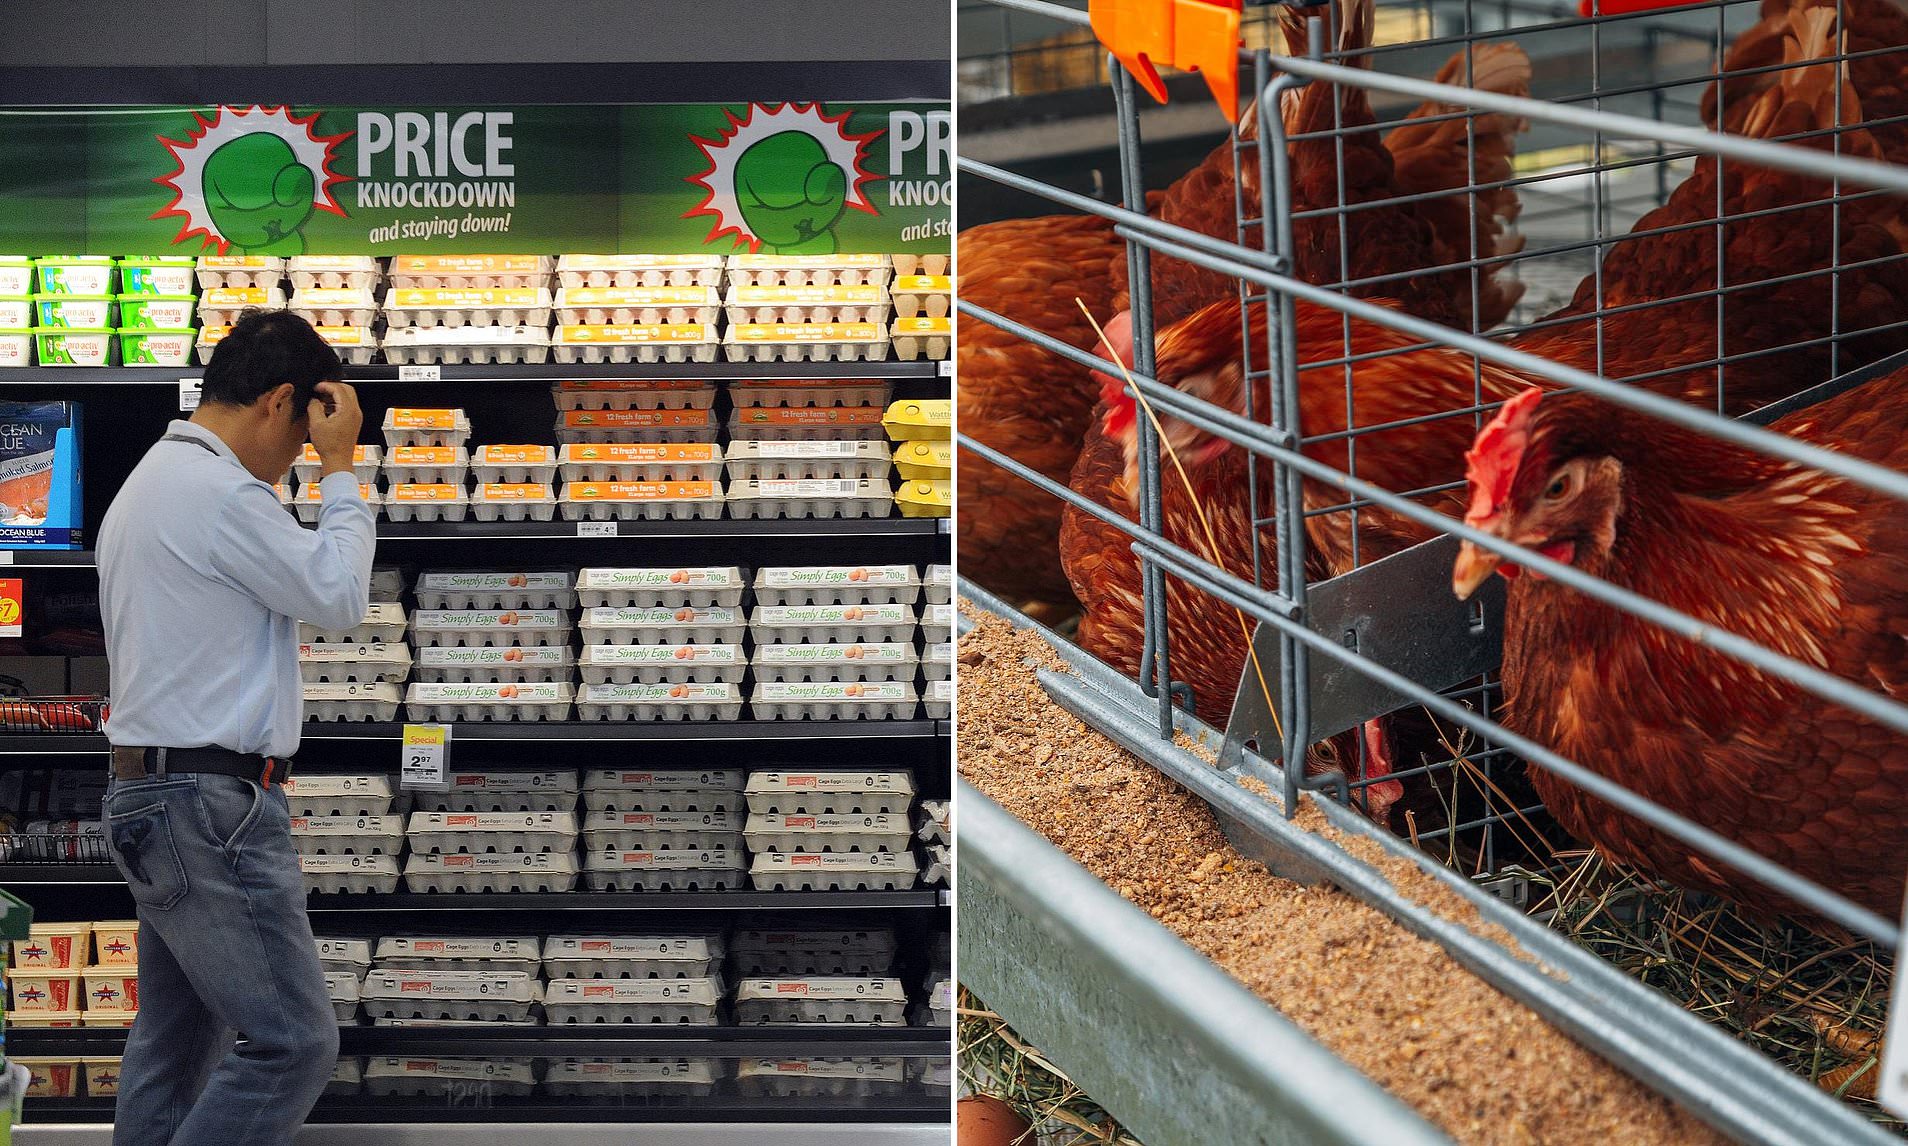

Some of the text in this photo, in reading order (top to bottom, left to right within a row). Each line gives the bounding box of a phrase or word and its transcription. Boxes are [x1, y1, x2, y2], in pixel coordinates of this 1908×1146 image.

[358, 111, 514, 177] PRICE
[889, 110, 951, 175] PR
[358, 182, 514, 207] KNOCKDOWN
[369, 213, 511, 243] and staying down!
[901, 218, 931, 242] and
[450, 575, 484, 588] Simply
[485, 575, 506, 588] Eggs
[544, 577, 564, 587] 700g
[612, 572, 645, 585] Simply
[646, 573, 668, 585] Eggs
[707, 574, 726, 583] 700g
[791, 570, 905, 583] Simply Eggs 700g
[441, 613, 554, 626] Simply Eggs 700g
[616, 611, 730, 623] Simply Eggs 700g
[785, 609, 900, 621] Simply Eggs 700g
[445, 650, 559, 663] Simply Eggs 700g
[616, 648, 731, 660] Simply Eggs 700g
[786, 647, 901, 659] Simply Eggs 700g
[440, 686, 555, 699] Simply Eggs 700g
[611, 686, 725, 699] Simply Eggs 700g
[786, 685, 901, 697] Simply Eggs 700g
[410, 736, 437, 744] Special
